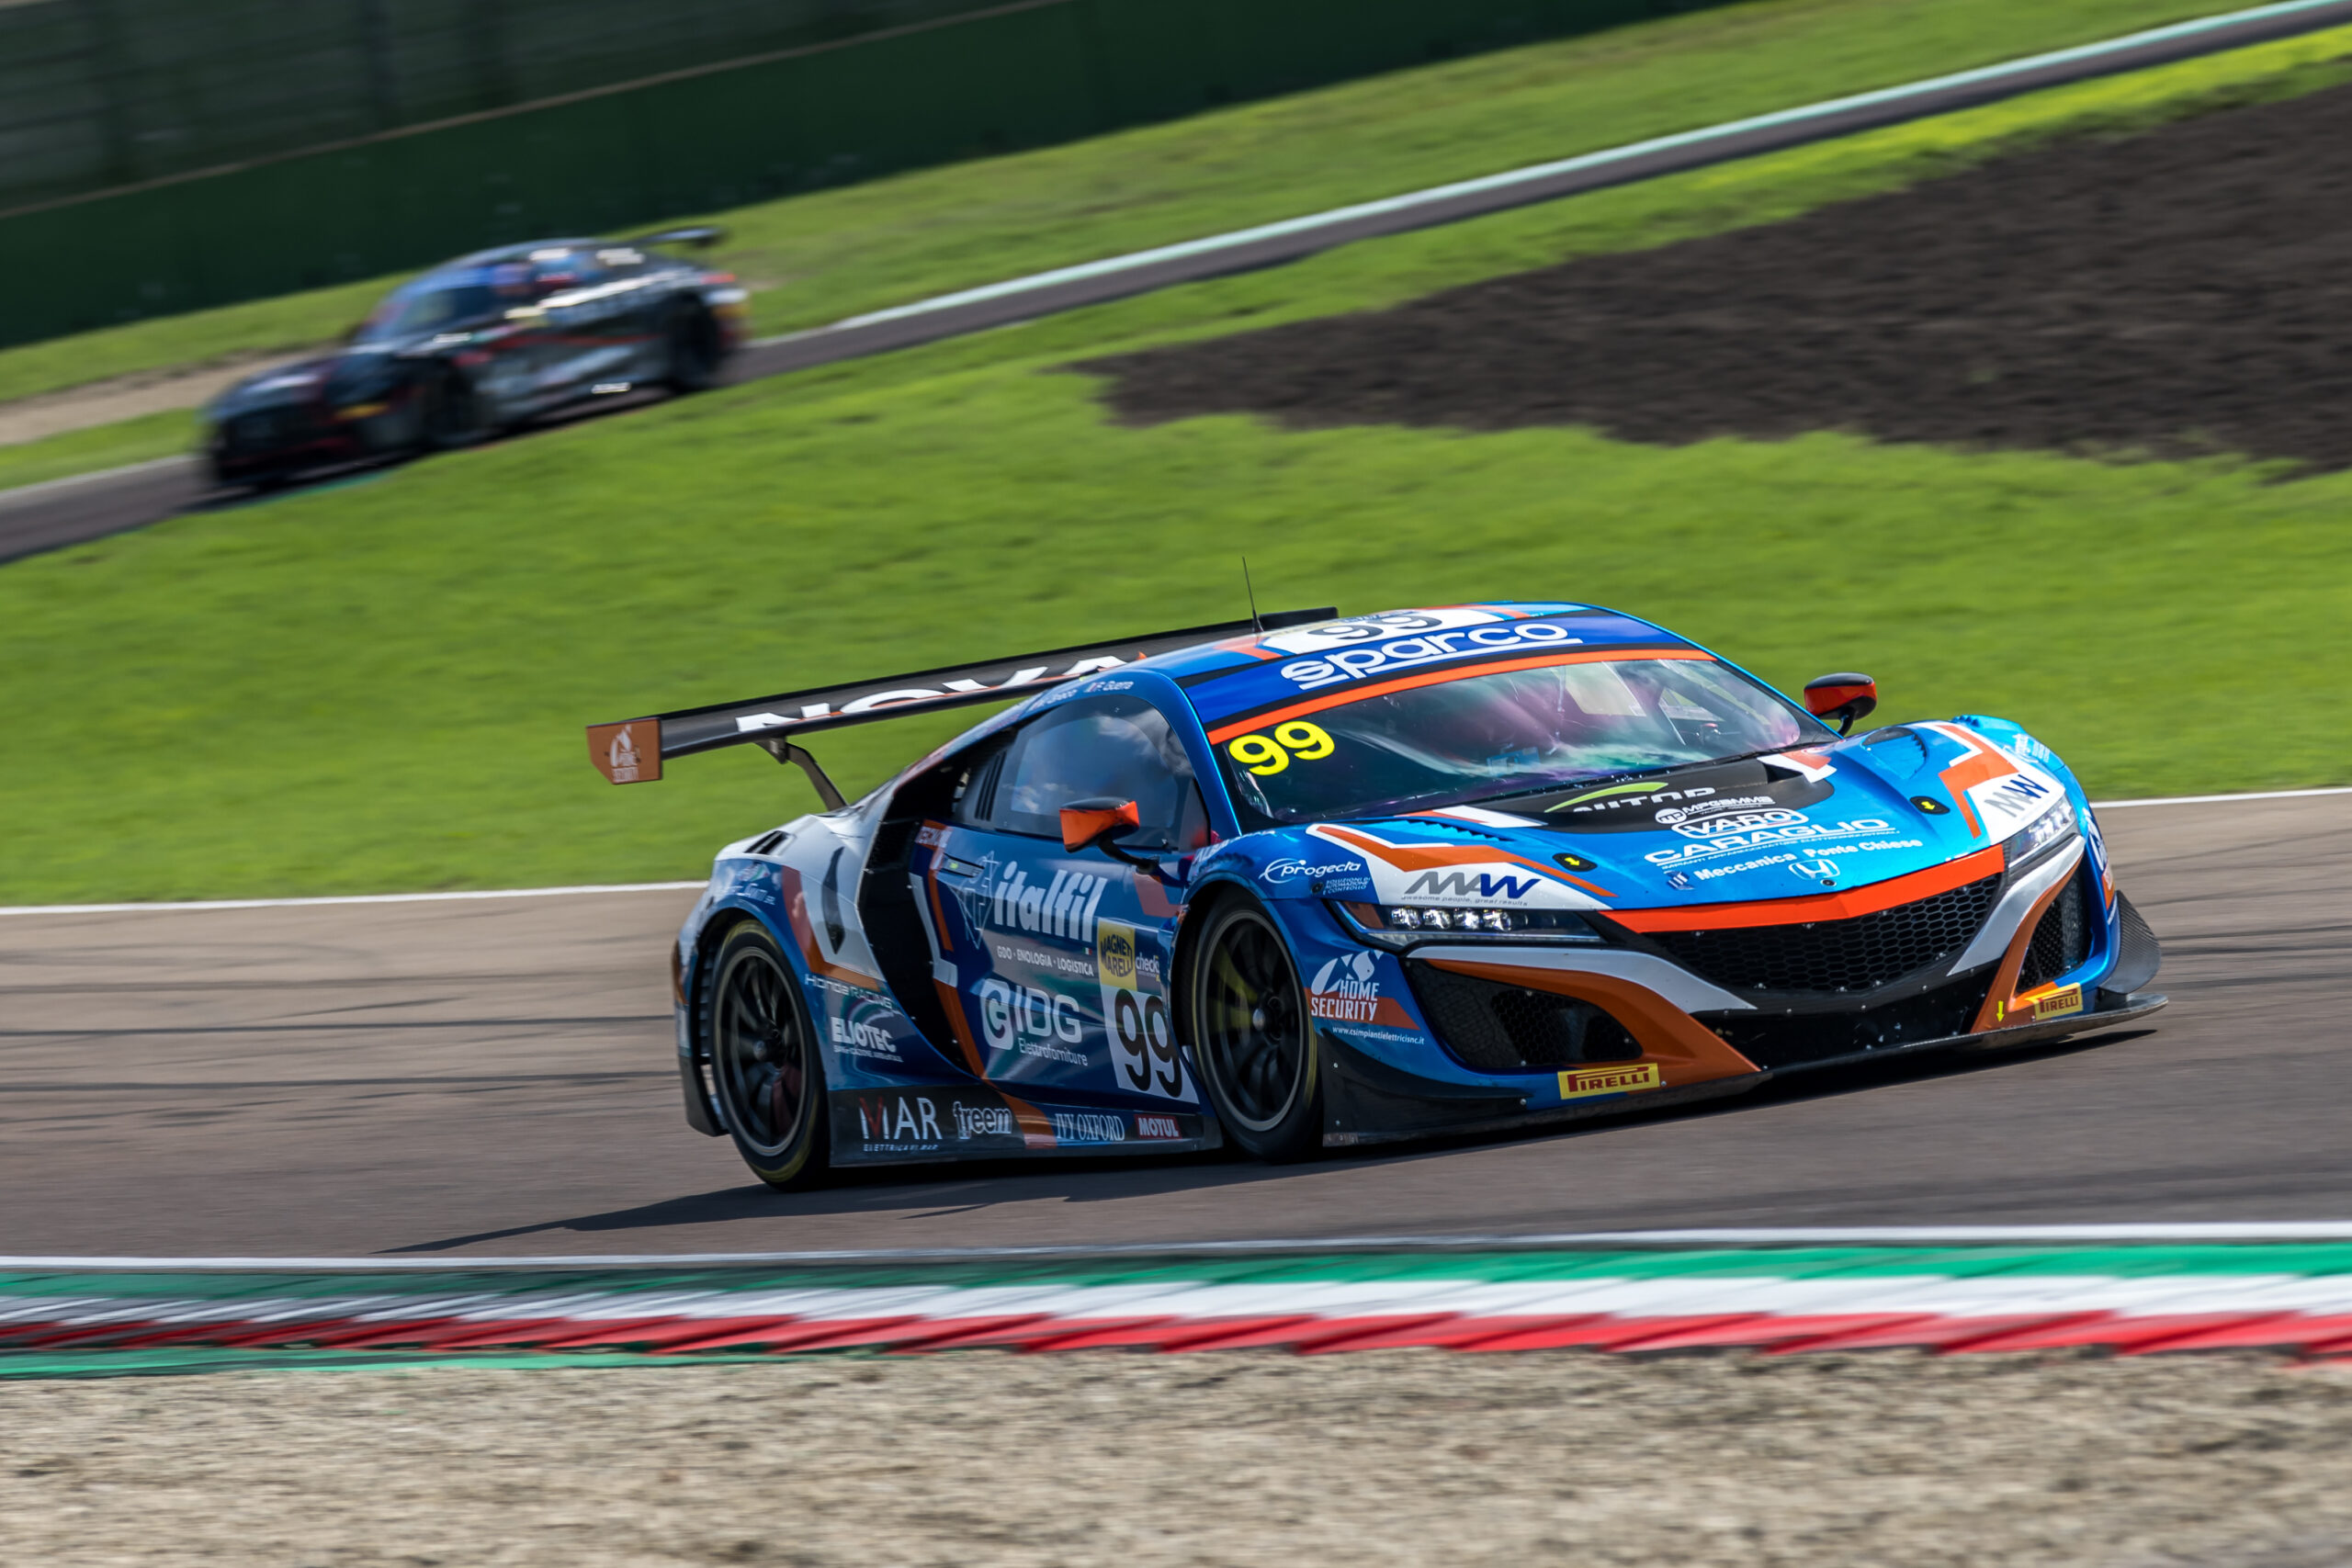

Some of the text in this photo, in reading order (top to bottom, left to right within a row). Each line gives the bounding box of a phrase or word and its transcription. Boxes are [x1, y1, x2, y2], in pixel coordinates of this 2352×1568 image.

[1307, 615, 1442, 640] 99
[1281, 624, 1568, 682] sparco
[1228, 721, 1335, 776] 99
[1684, 811, 1792, 835] VARO
[1645, 818, 1890, 863] CARAGLIO
[1693, 840, 1923, 880] Meccanica Ponte Chiese
[994, 861, 1108, 942] italfil
[997, 944, 1094, 977] GDO ENOLOGIA LOGISTICA
[1339, 979, 1380, 1002] HOME
[2037, 988, 2079, 1013] PIRELLI
[1311, 997, 1378, 1021] SECURITY
[831, 1016, 897, 1054] ELIOTEC
[1114, 988, 1183, 1099] 99
[1566, 1066, 1650, 1093] PIRELLI
[953, 1100, 1012, 1140] freem
[1055, 1113, 1125, 1142] IVY OXFORD
[1137, 1117, 1180, 1138] MOTUL
